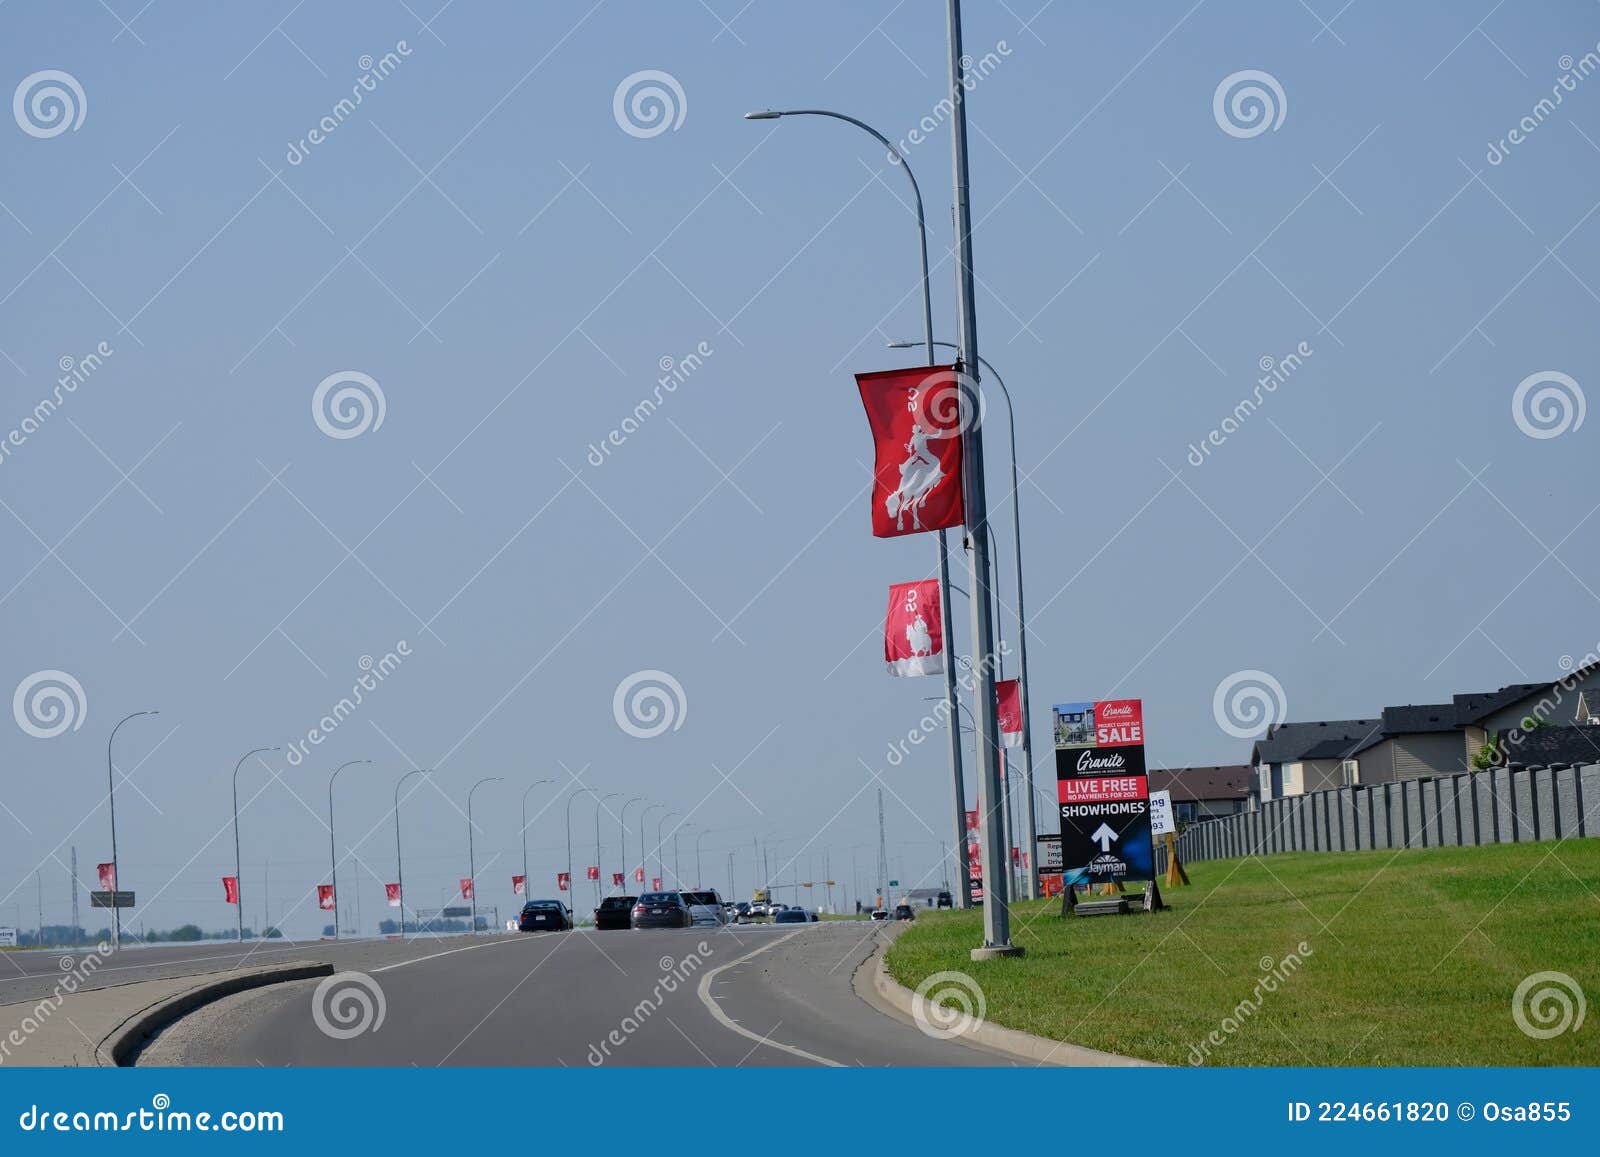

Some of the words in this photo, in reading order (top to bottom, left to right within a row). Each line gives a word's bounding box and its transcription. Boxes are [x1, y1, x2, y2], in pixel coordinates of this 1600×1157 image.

[1102, 703, 1133, 717] Granite
[1098, 726, 1141, 743] SALE
[1077, 750, 1126, 771] Granite
[1067, 780, 1098, 794] LIVE
[1102, 778, 1137, 792] FREE
[1077, 792, 1109, 800] PAYMENTS
[1110, 791, 1122, 799] FOR
[1062, 801, 1146, 818] SHOWHOMES
[1088, 861, 1127, 876] Jayman
